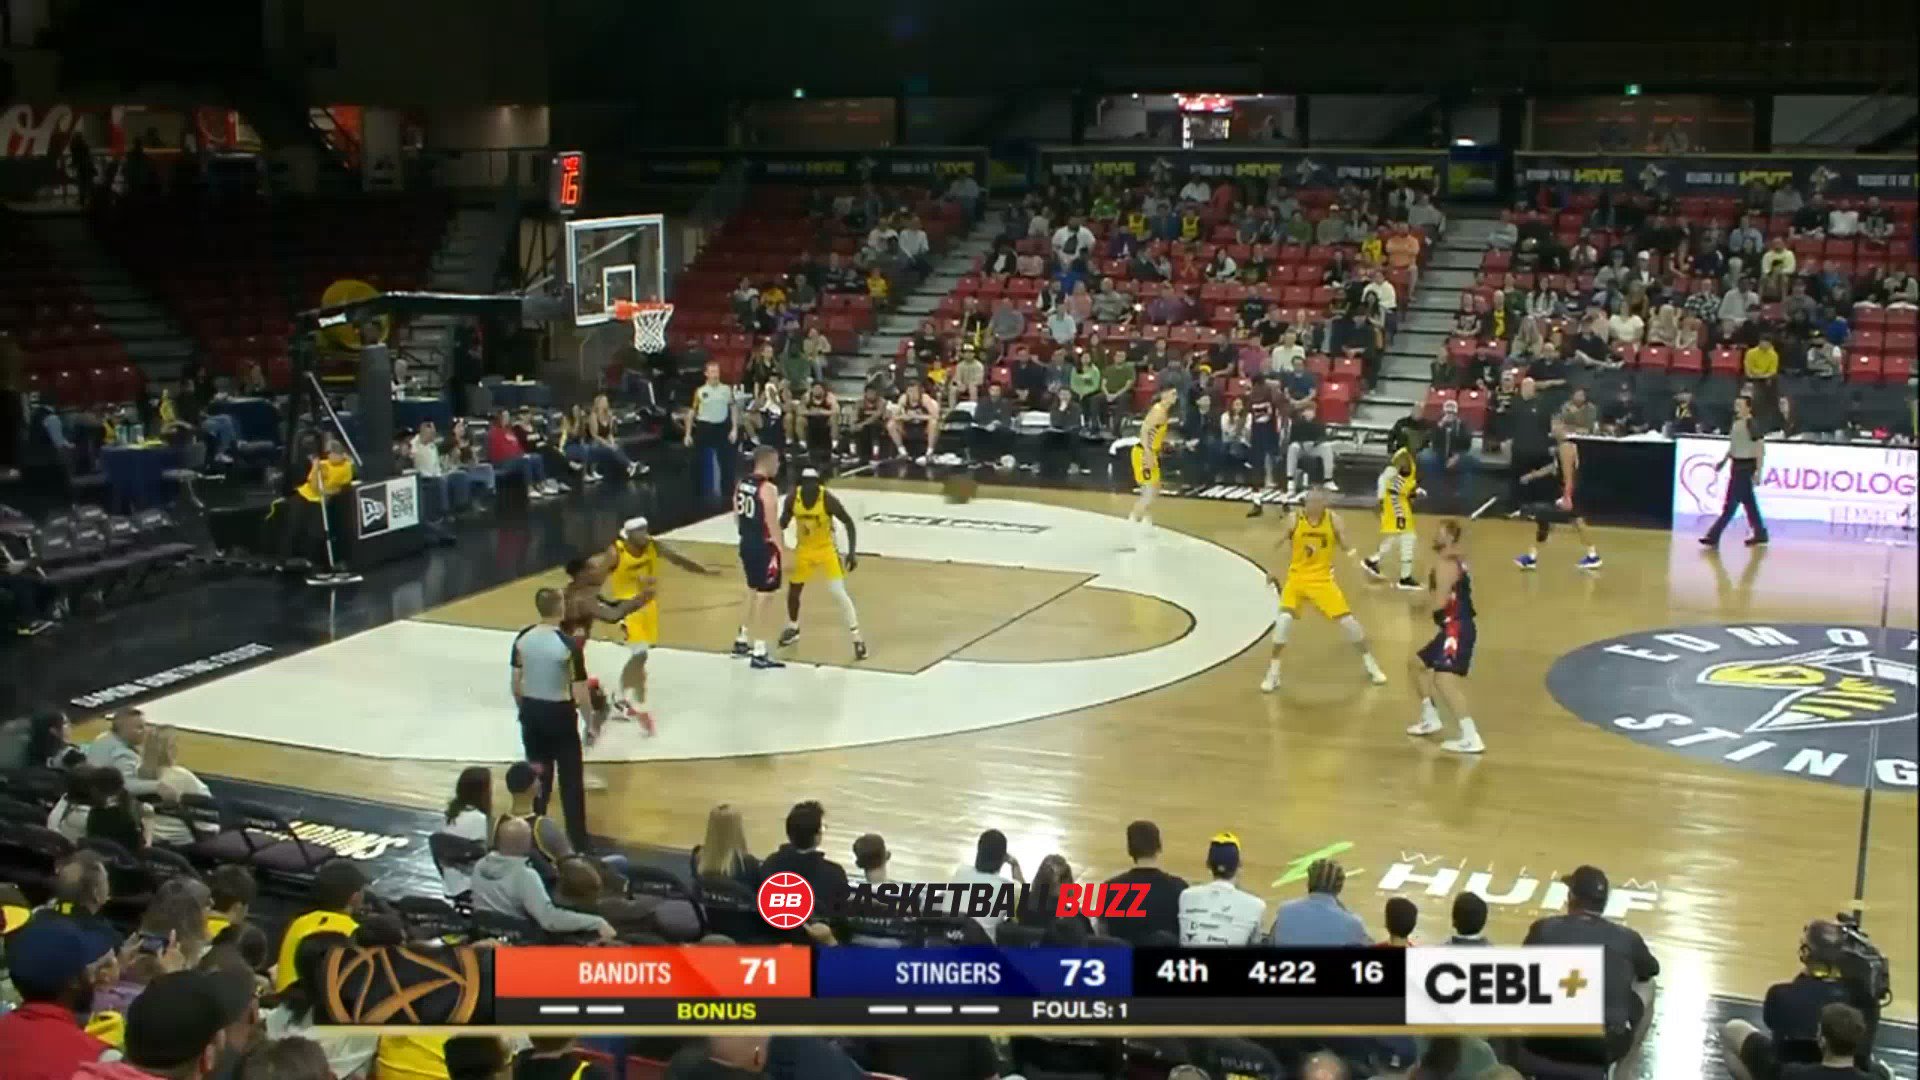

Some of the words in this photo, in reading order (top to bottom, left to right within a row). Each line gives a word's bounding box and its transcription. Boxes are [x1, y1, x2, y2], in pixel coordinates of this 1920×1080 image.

[1574, 168, 1624, 184] HIVE
[1764, 467, 1916, 496] AUDIOLOG
[737, 493, 756, 518] 30
